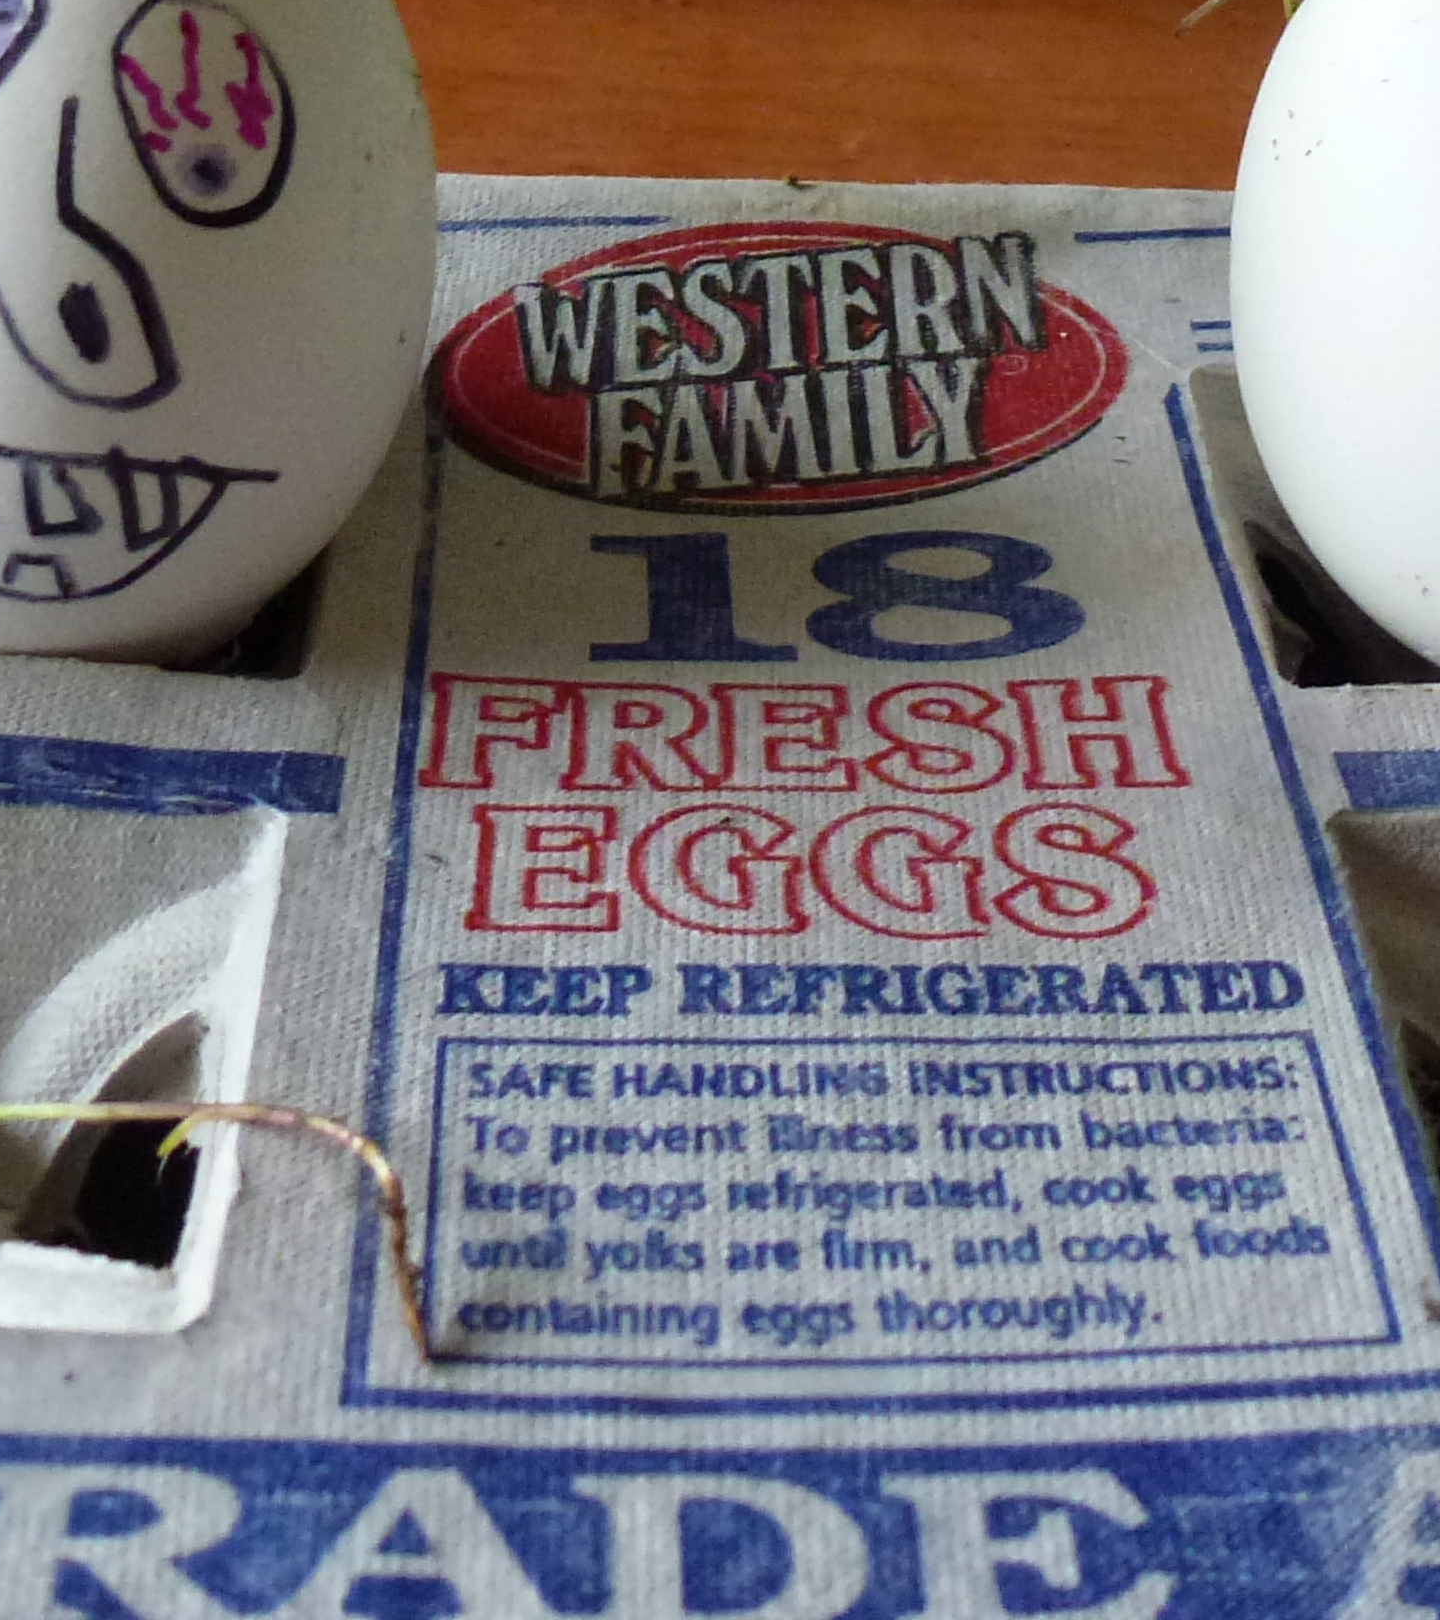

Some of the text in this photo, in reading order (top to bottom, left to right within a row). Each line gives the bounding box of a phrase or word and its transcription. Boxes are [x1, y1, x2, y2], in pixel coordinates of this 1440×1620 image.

[512, 232, 1050, 392] WESTERN
[588, 352, 998, 502] FAMILY
[588, 530, 1087, 662] 18
[417, 672, 1190, 792] FRESH
[464, 802, 1160, 940] EGGS
[435, 960, 1305, 1018] KEEP REFRIGERATED
[467, 1056, 1300, 1100] SAFE HANDLING INSTRUCTIONS:
[465, 1115, 530, 1156] To
[550, 1119, 748, 1165] prevent
[768, 1113, 920, 1155] illness
[938, 1113, 1061, 1153] from
[464, 1165, 1298, 1226] keep eggs refrigerated, cook eggs
[462, 1215, 1332, 1283] until yolks are firm, and cook foods
[458, 1280, 1163, 1348] containing eggs thoroughly.
